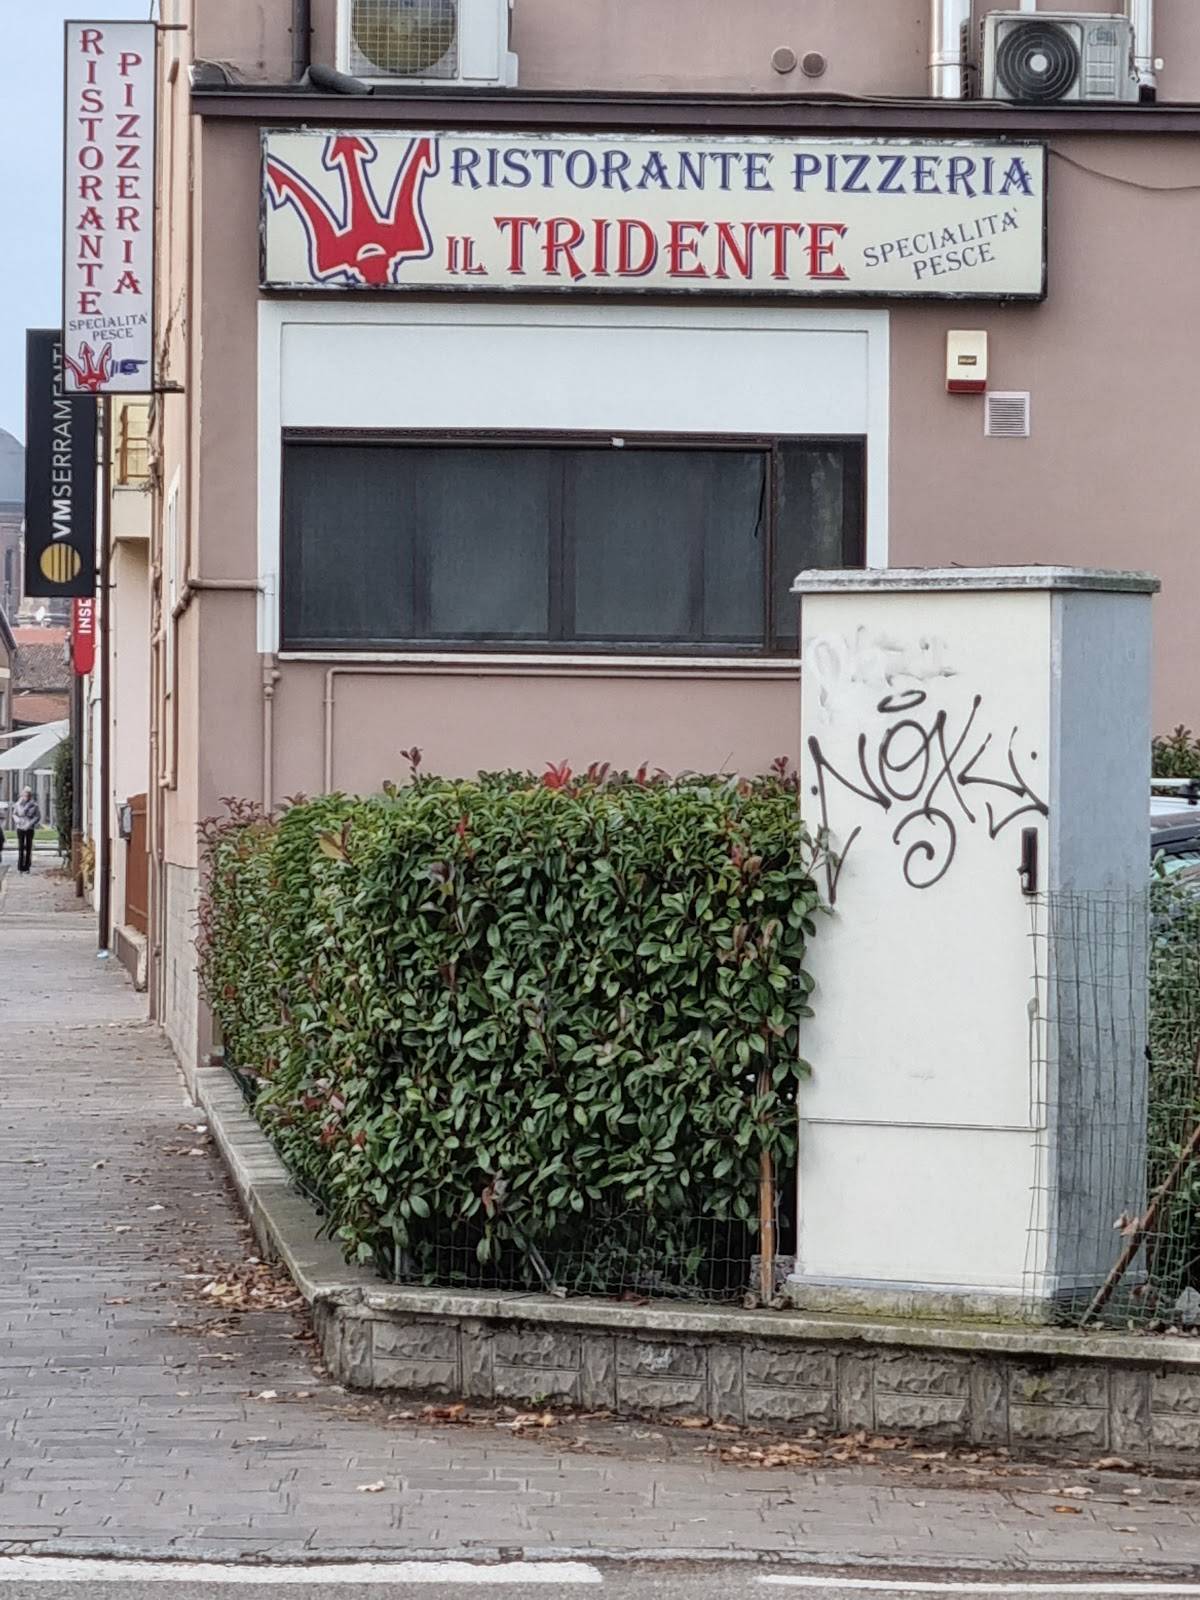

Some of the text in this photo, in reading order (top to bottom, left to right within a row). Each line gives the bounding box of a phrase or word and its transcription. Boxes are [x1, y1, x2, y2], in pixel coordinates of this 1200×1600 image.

[76, 28, 105, 316] RISTORANTE
[112, 51, 143, 296] PIZZERIA
[450, 146, 1035, 197] RISTORANTE PIZZERIA
[445, 215, 851, 283] IL TRIDENTE
[912, 242, 996, 281] PESCE
[92, 327, 134, 341] PESCE
